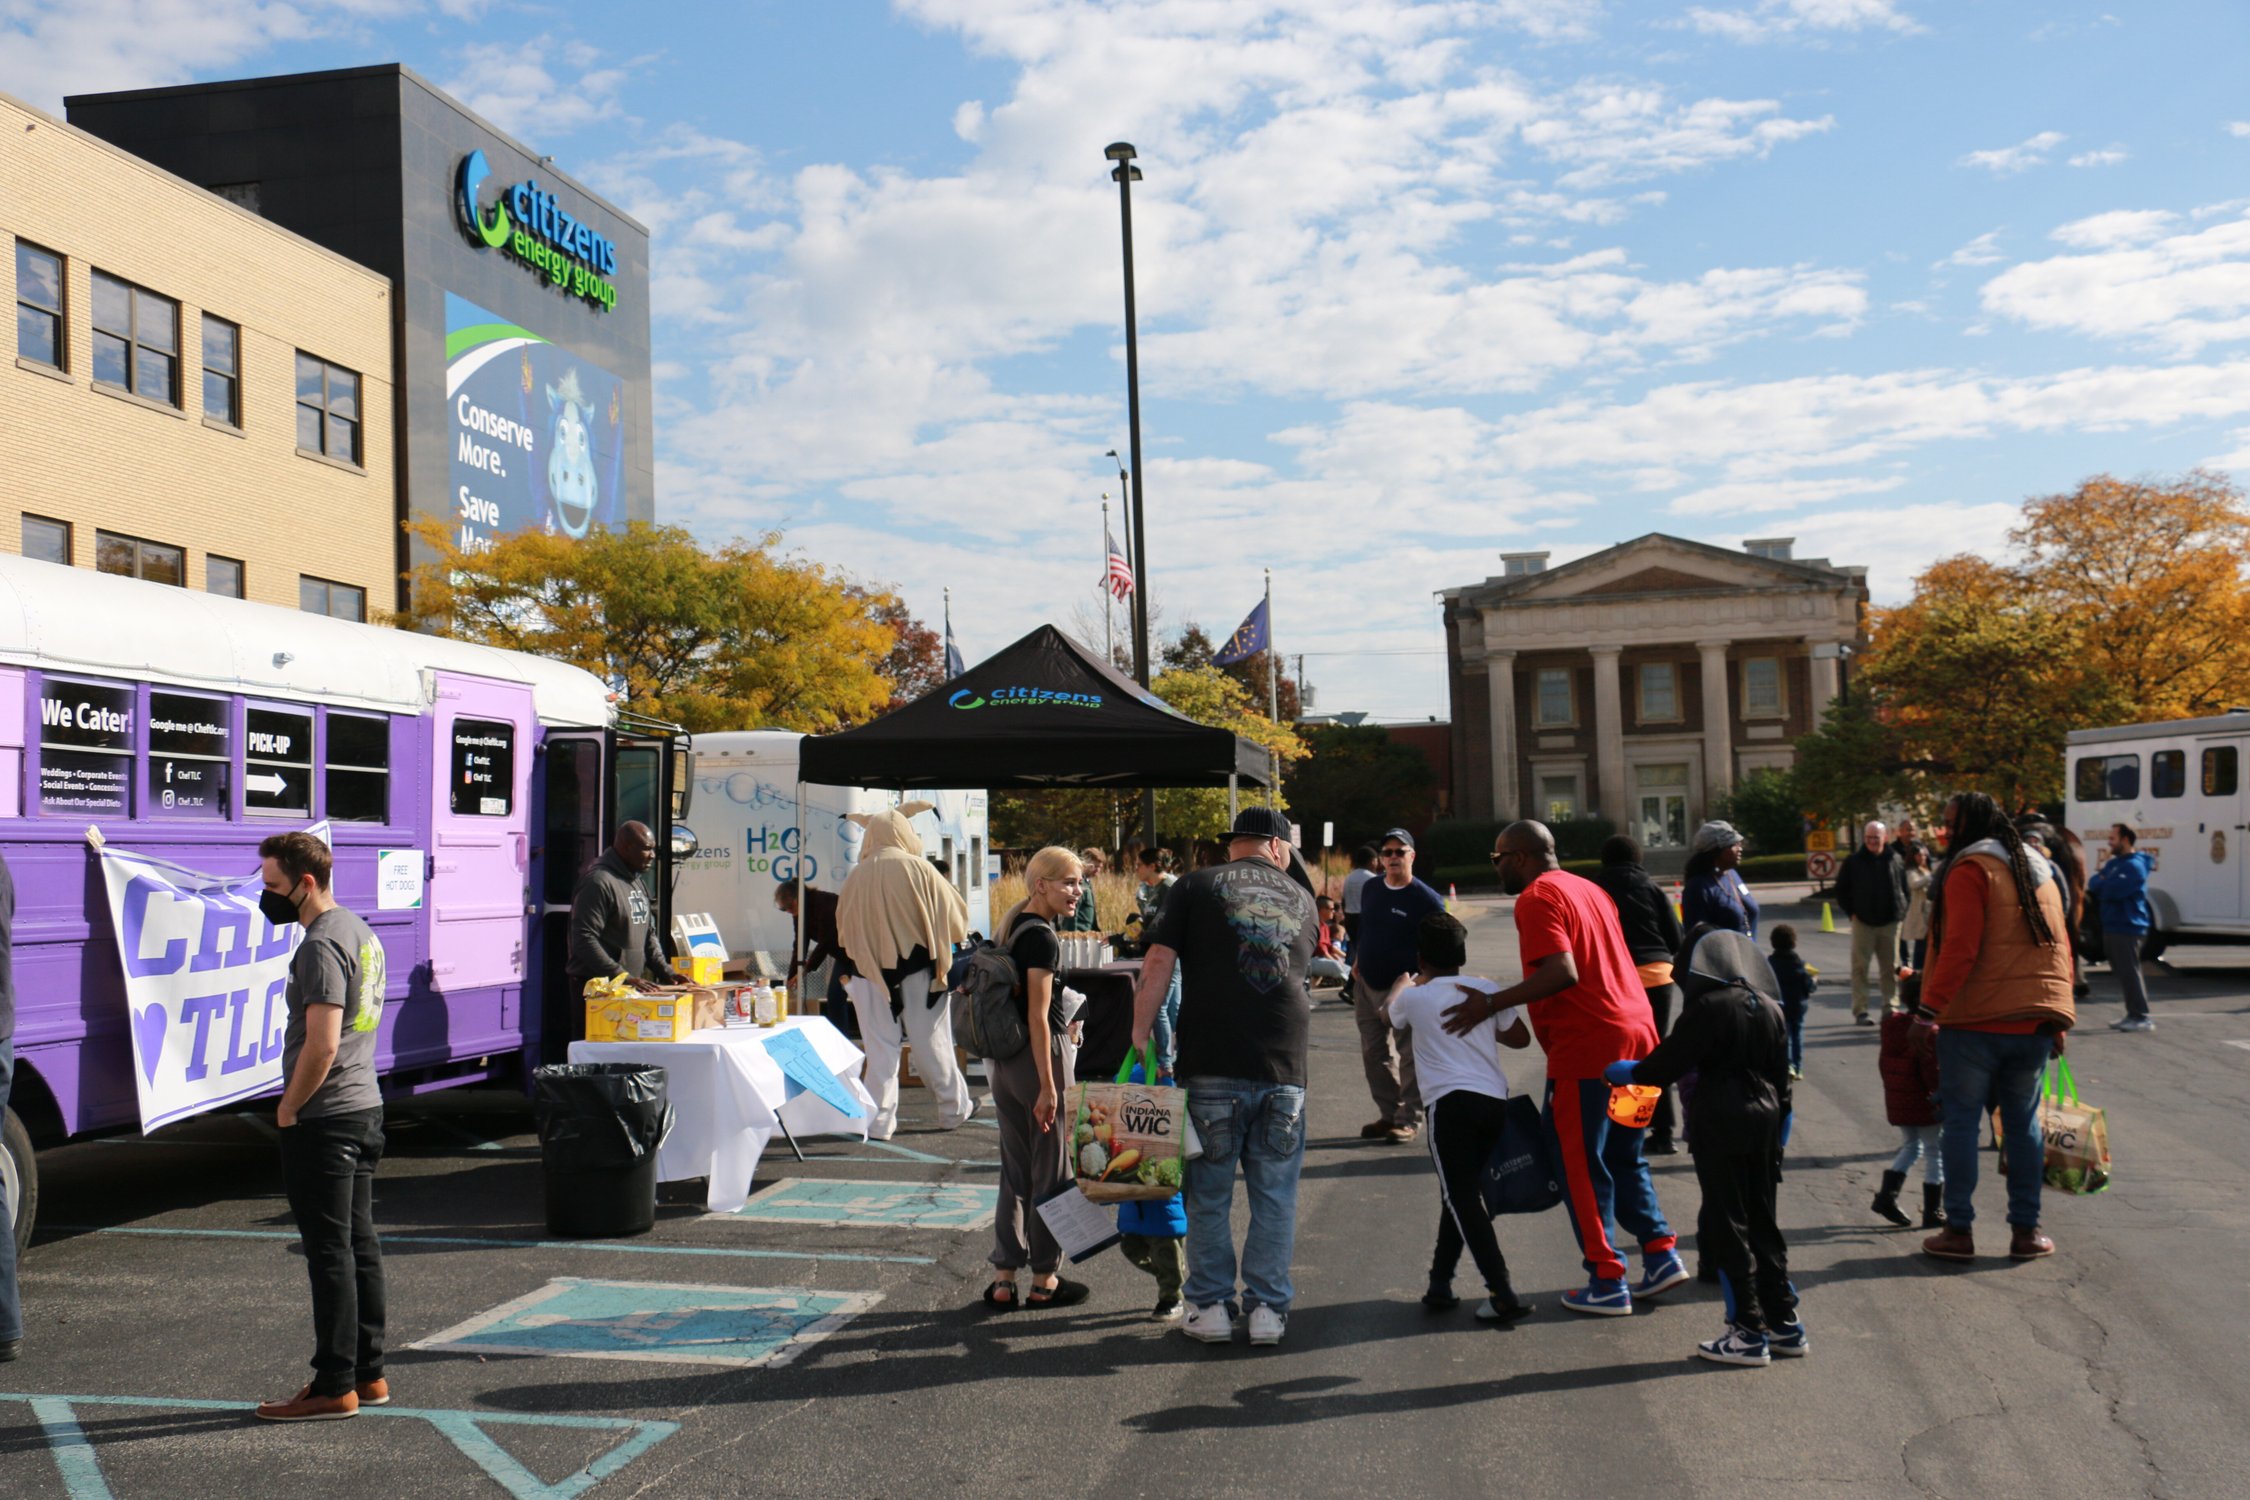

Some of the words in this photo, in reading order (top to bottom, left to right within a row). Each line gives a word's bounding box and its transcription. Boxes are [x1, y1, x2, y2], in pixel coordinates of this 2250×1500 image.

[510, 180, 618, 276] citizens
[513, 231, 570, 288] energy
[574, 265, 617, 313] group
[457, 394, 533, 451] Conserve
[458, 432, 507, 477] More.
[459, 485, 499, 527] Save
[459, 525, 499, 555] Mor
[989, 698, 1048, 706] energy
[991, 687, 1102, 703] citizens
[40, 697, 73, 728] We
[76, 702, 133, 733] Cater!
[149, 718, 175, 733] Google
[175, 722, 187, 732] me
[248, 732, 291, 754] PICK-UP
[41, 767, 72, 779] Weddings
[77, 769, 107, 780] Corporate
[108, 771, 128, 780] Events
[43, 780, 63, 789] Social
[63, 781, 85, 791] Events
[89, 782, 126, 792] Concessions
[56, 797, 73, 806] About
[74, 798, 86, 806] Our
[86, 798, 105, 808] Special
[695, 847, 731, 858] zens
[393, 864, 409, 875] FREE
[703, 859, 731, 870] group
[748, 856, 769, 872] to
[771, 854, 818, 882] GO
[386, 879, 398, 891] HOT
[399, 879, 415, 891] DOGS
[180, 977, 286, 1083] TLC
[1126, 1105, 1171, 1118] INDIANA
[1126, 1115, 1171, 1136] WIC
